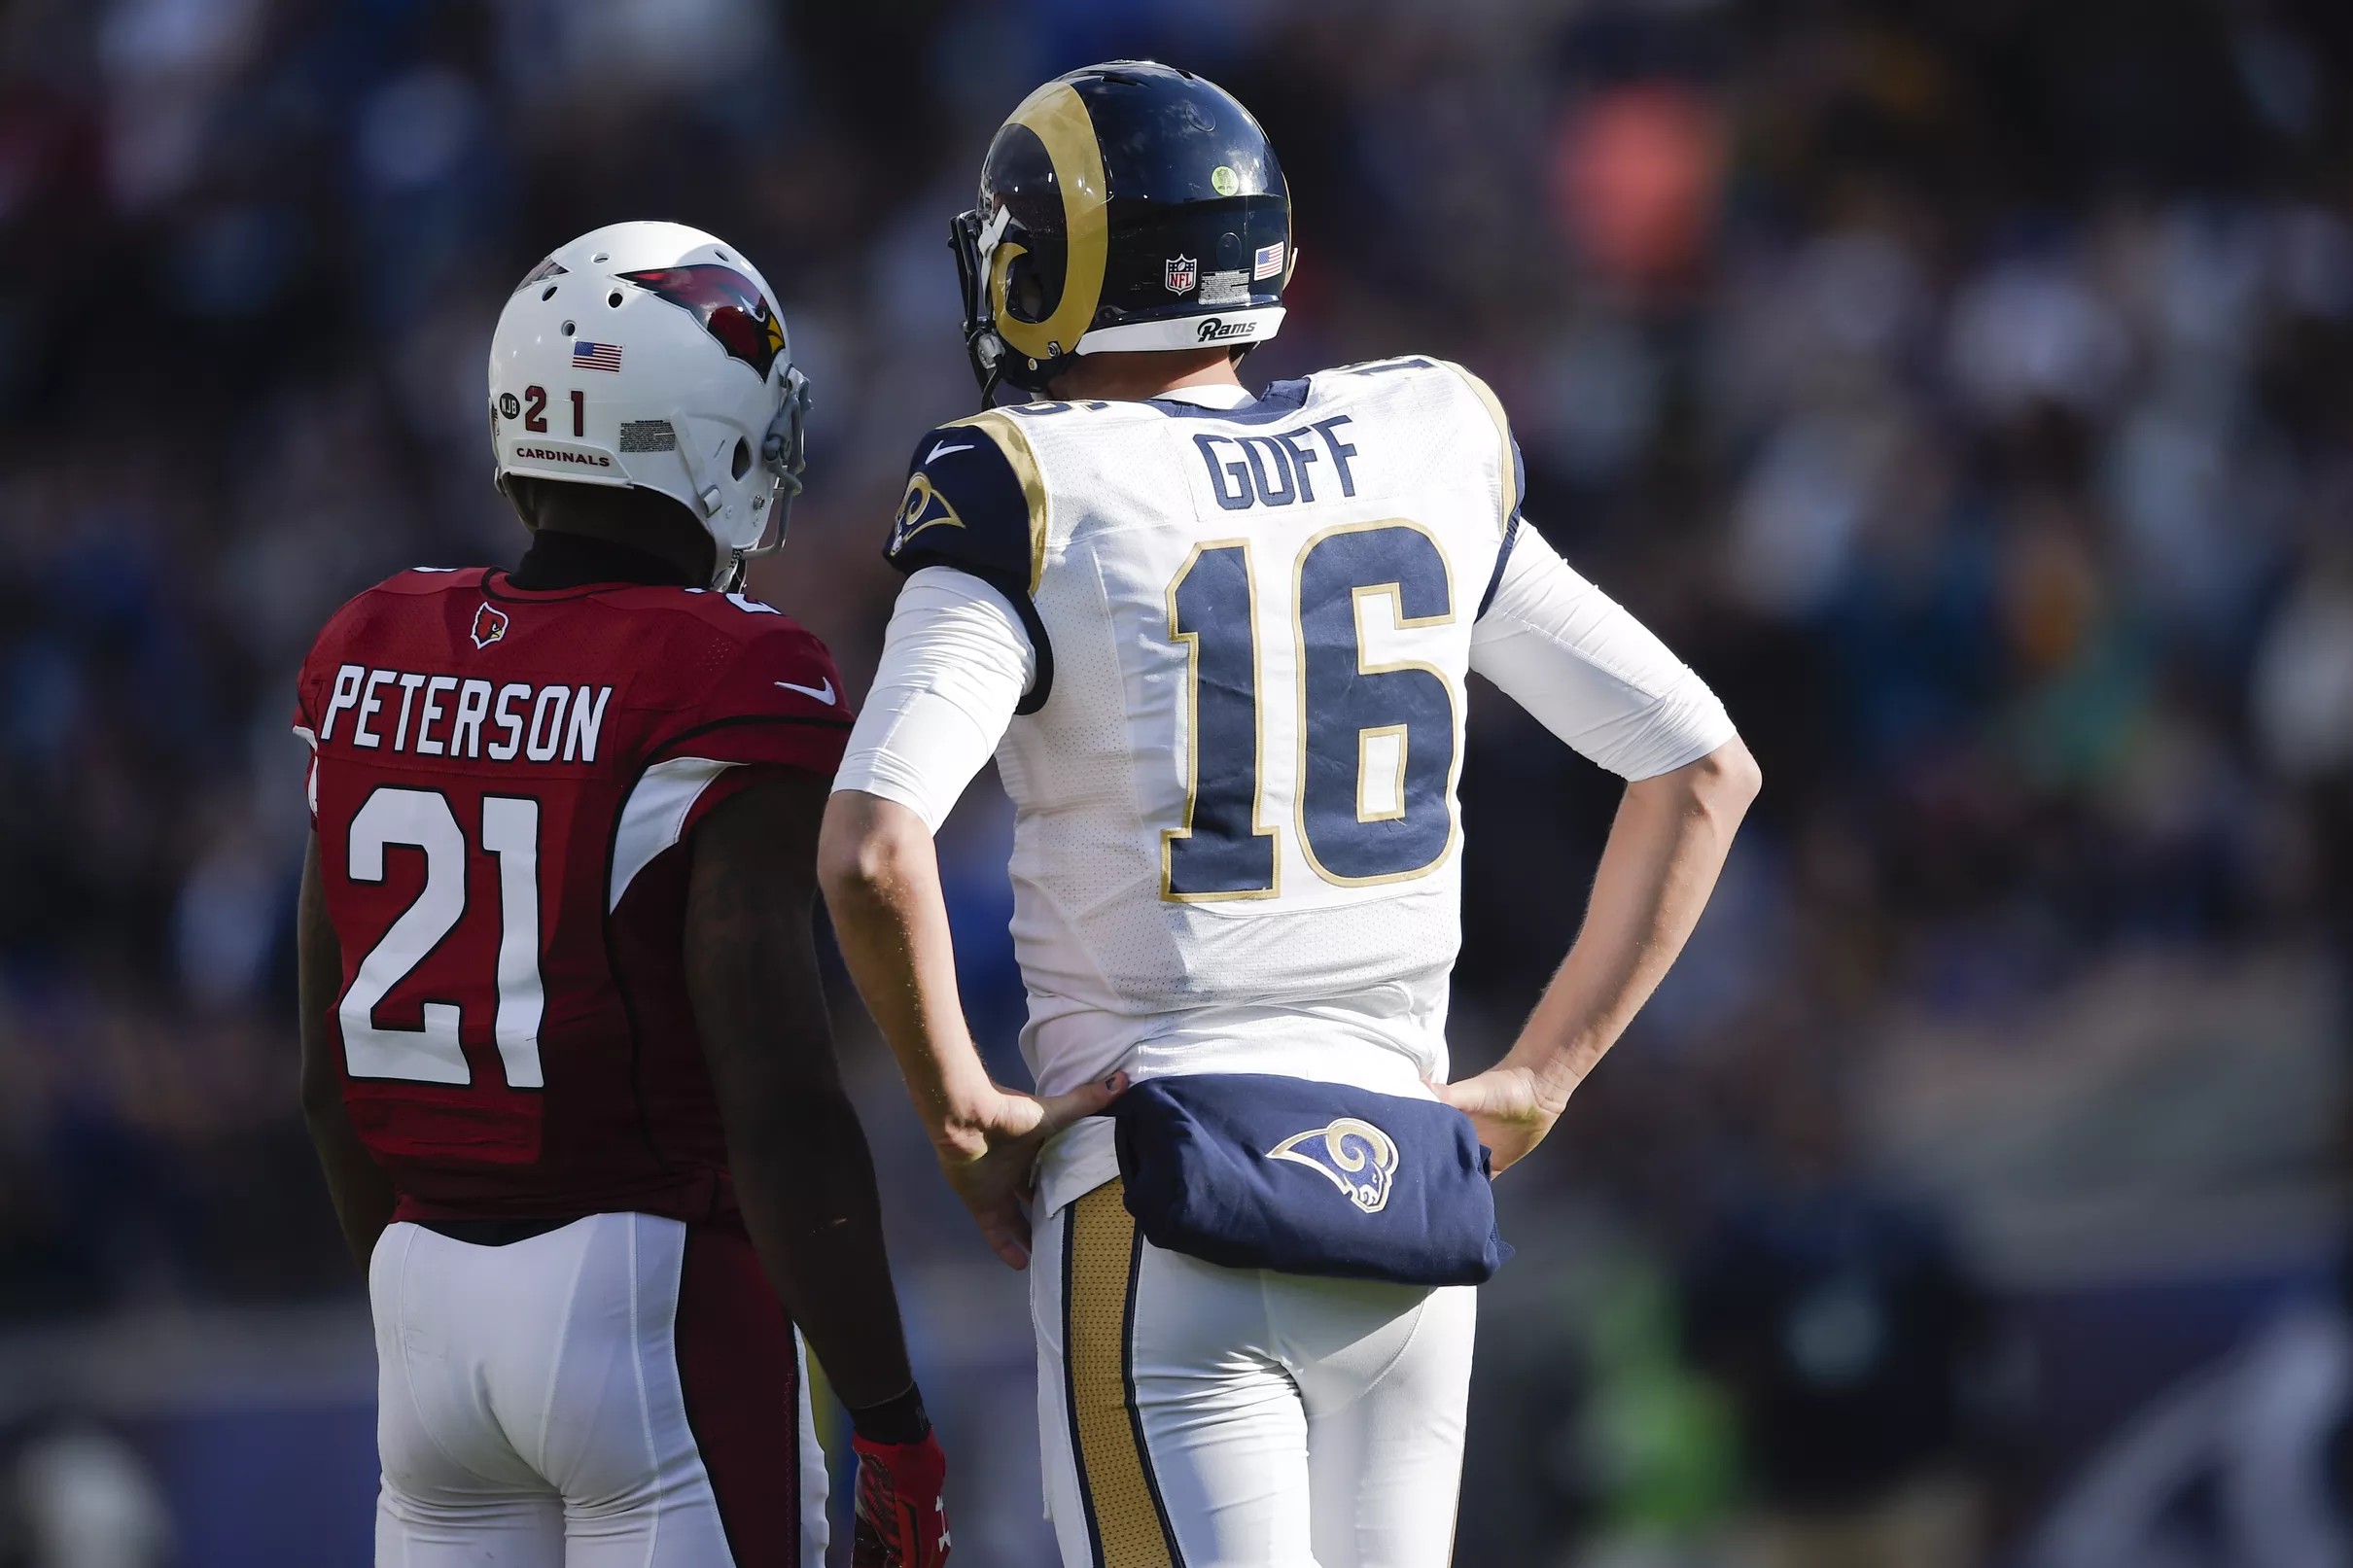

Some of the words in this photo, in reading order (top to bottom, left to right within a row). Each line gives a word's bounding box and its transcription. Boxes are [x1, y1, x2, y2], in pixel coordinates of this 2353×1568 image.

[1170, 273, 1192, 289] NFL
[1197, 318, 1257, 342] Rams
[501, 398, 517, 415] NJB
[516, 447, 611, 468] CARDINALS
[1192, 414, 1357, 511] GOFF
[319, 663, 614, 764] PETERSON
[1160, 516, 1457, 902] 16
[337, 784, 545, 1090] 21
